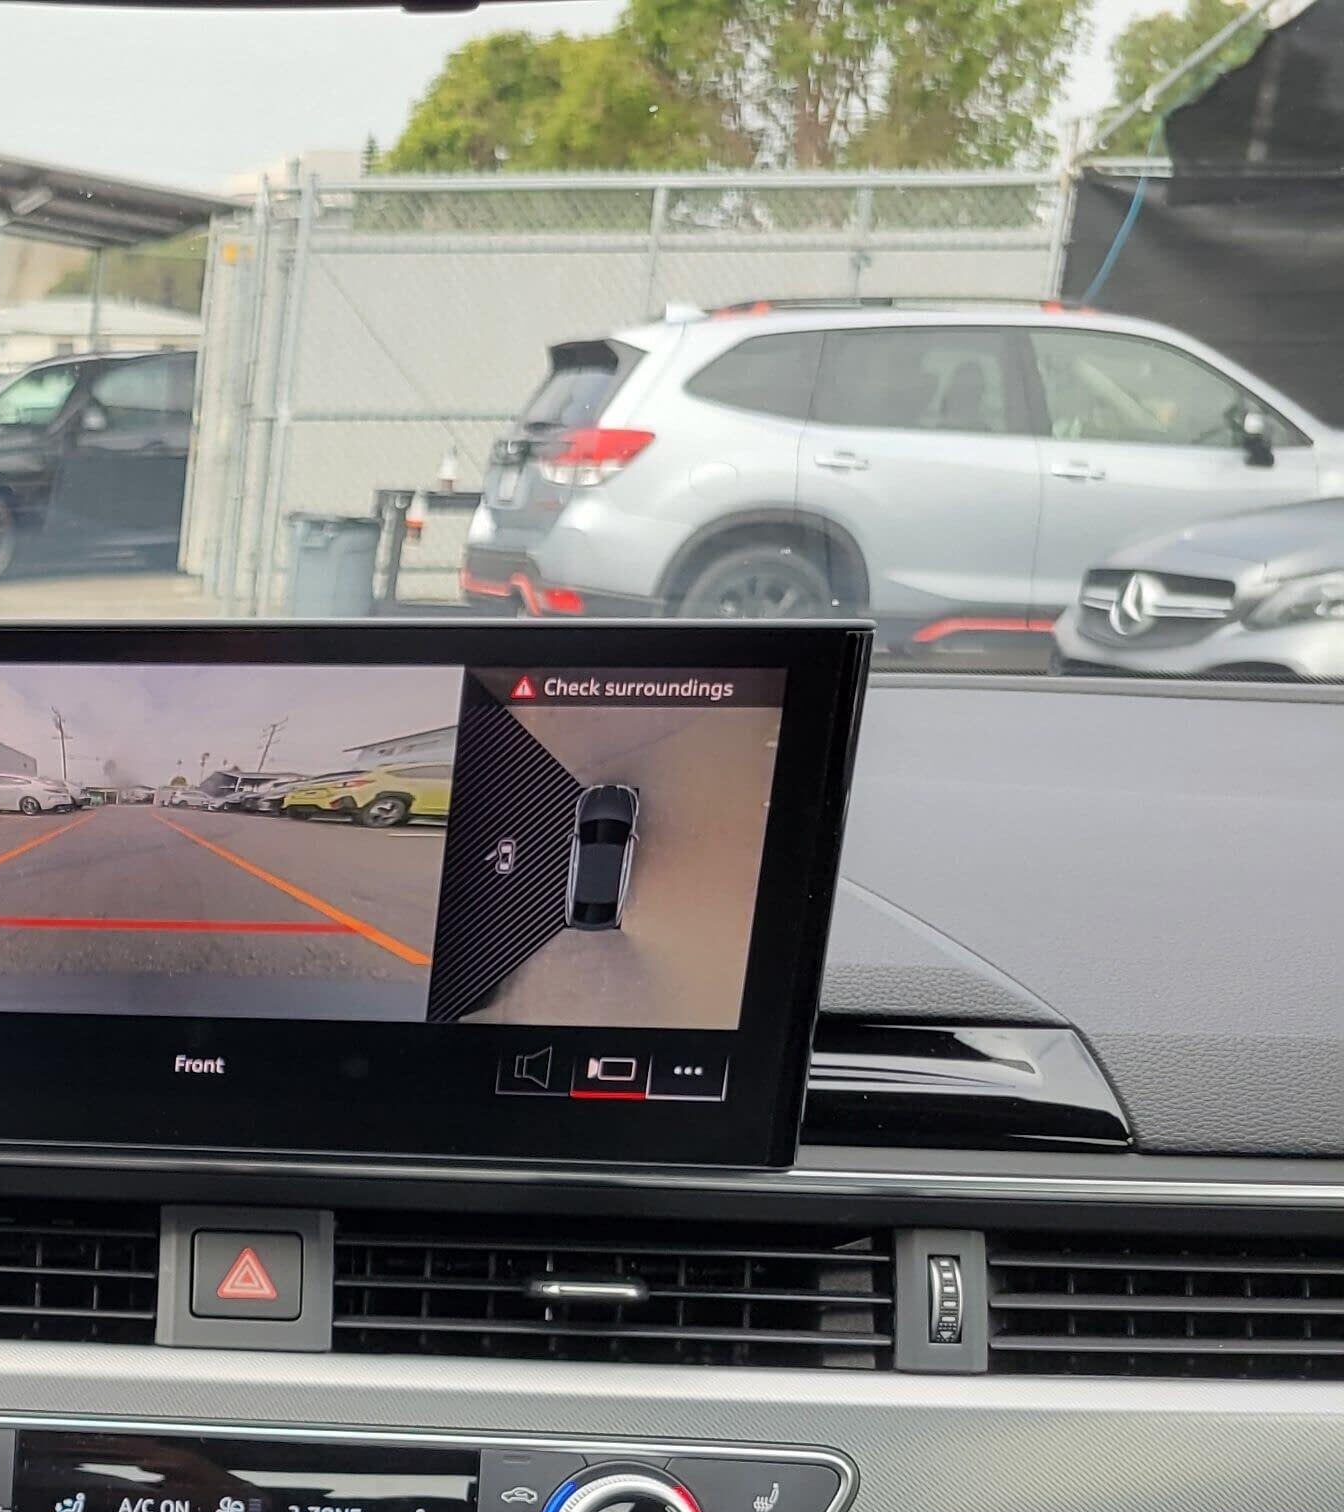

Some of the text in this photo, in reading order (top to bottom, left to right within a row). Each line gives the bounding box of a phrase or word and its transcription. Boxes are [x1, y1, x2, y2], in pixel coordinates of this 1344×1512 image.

[544, 677, 734, 701] Check surroundings
[174, 1054, 226, 1074] Front
